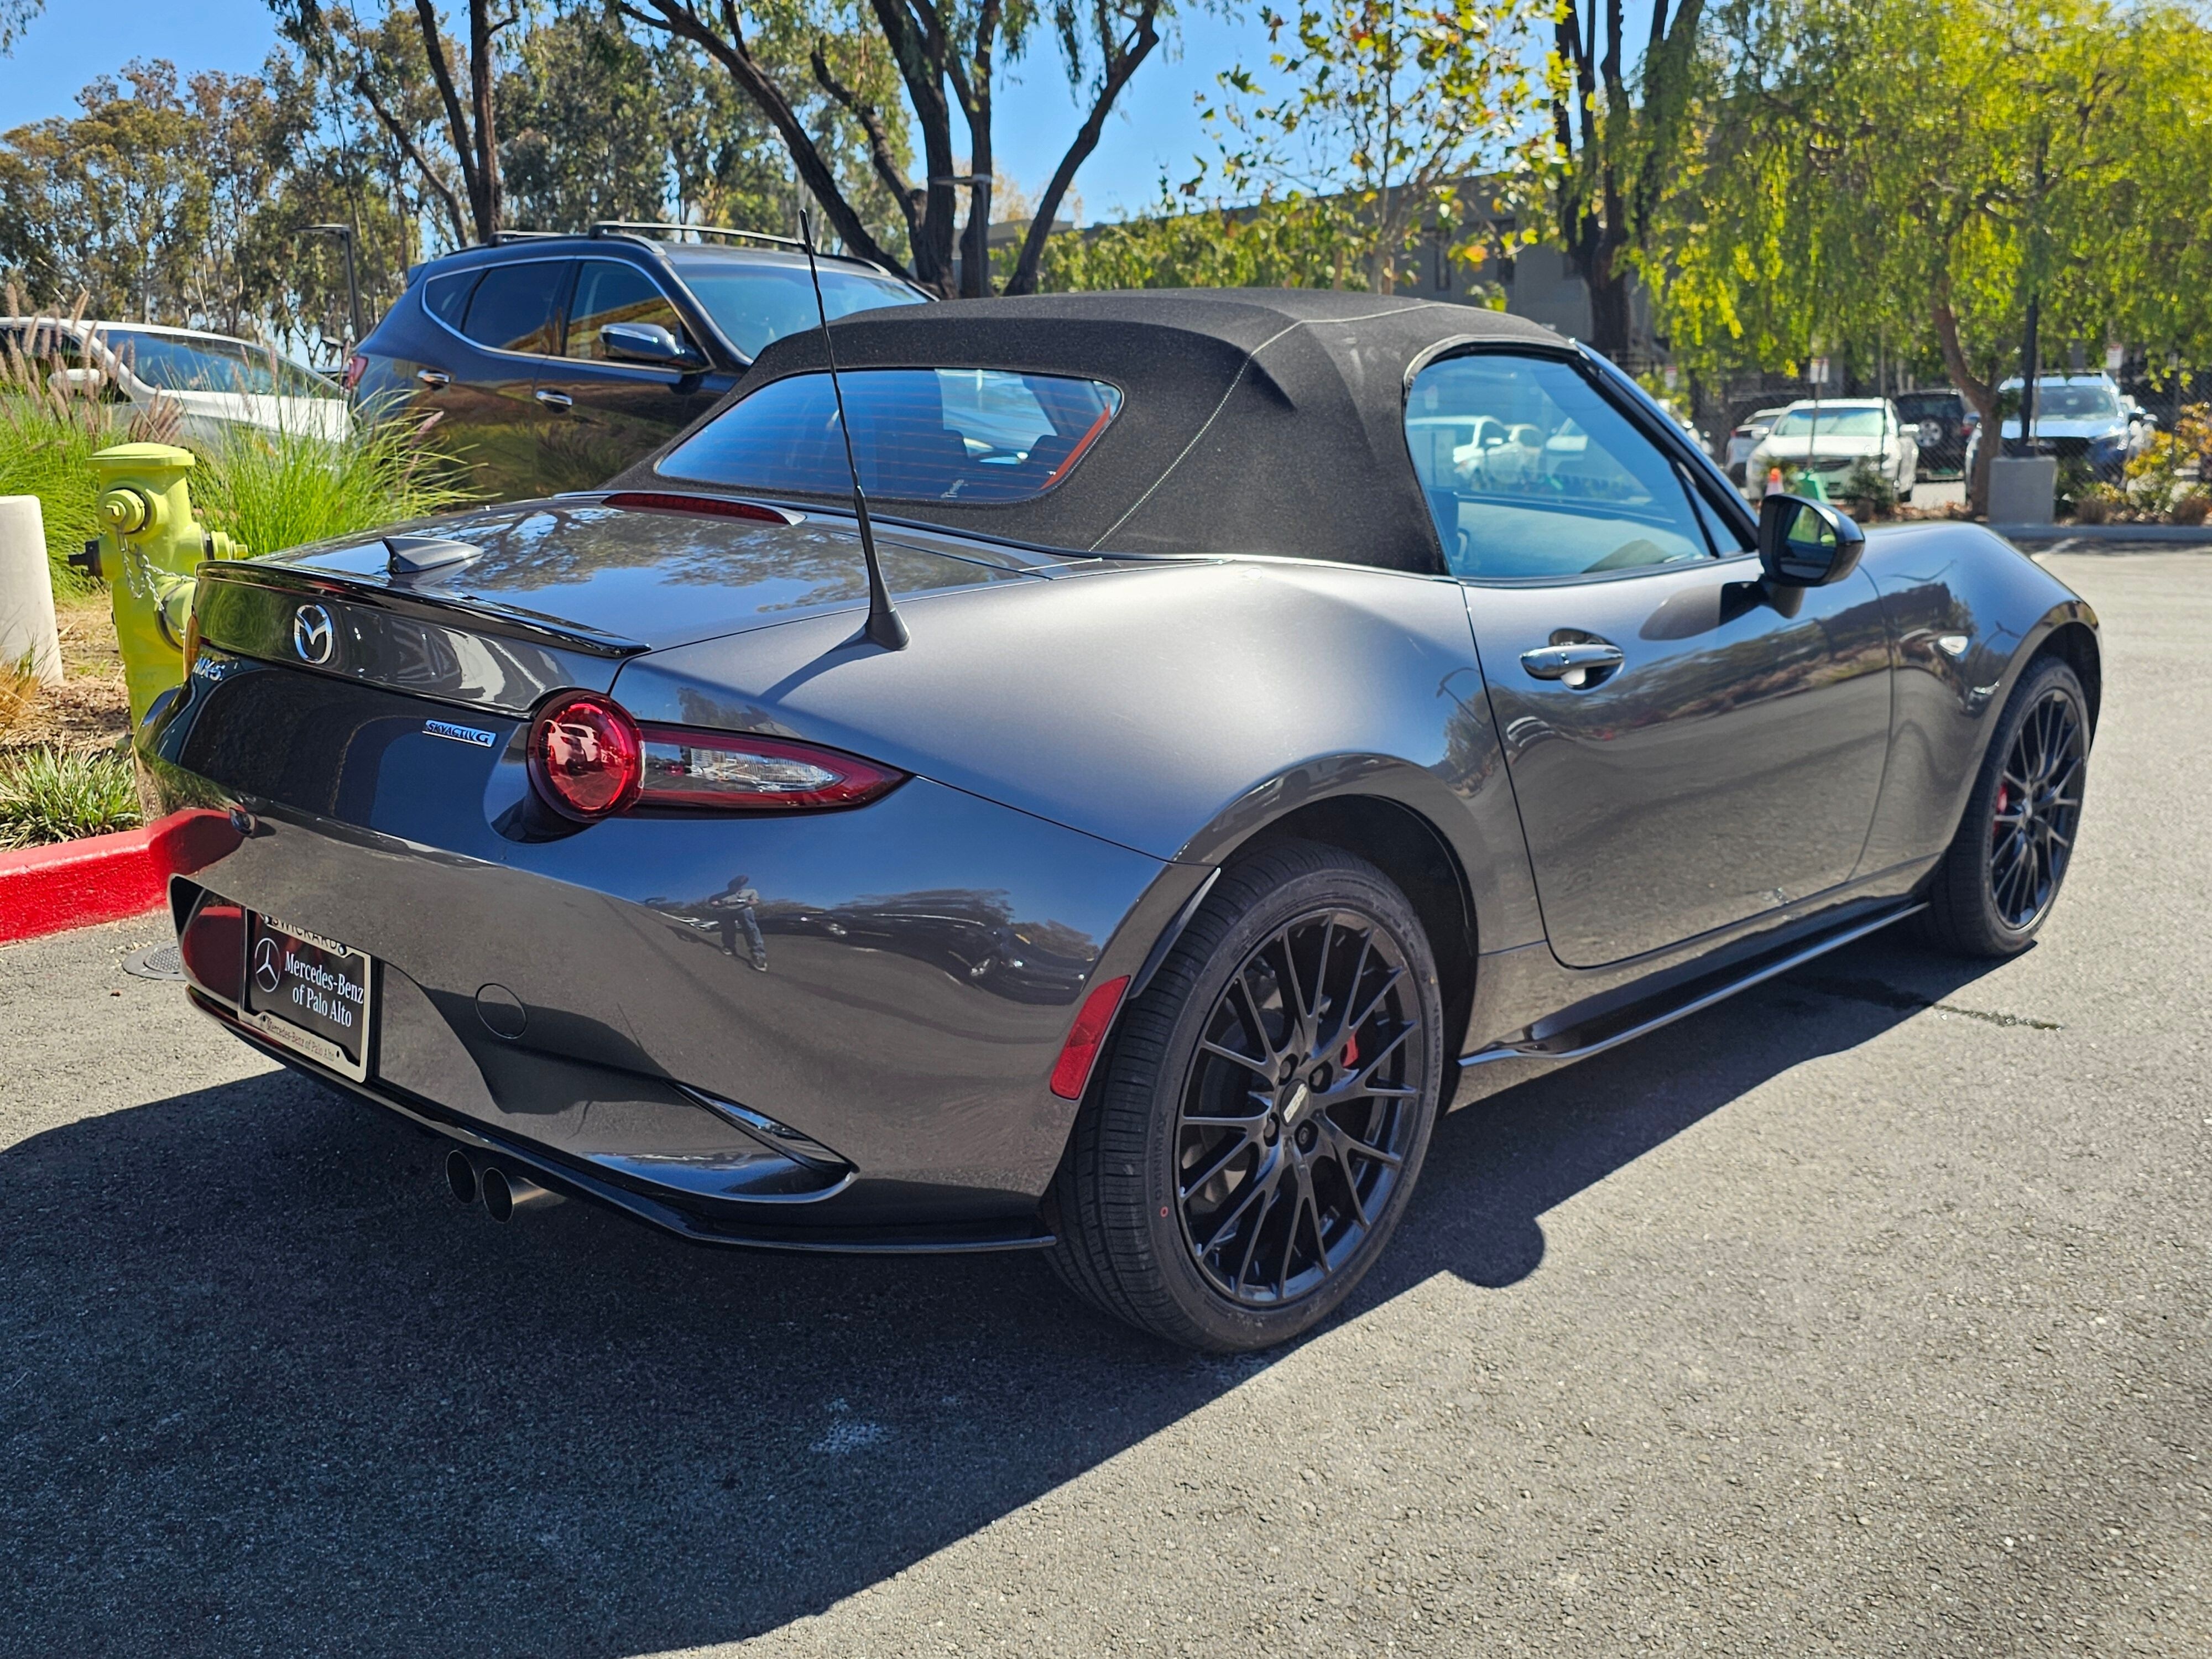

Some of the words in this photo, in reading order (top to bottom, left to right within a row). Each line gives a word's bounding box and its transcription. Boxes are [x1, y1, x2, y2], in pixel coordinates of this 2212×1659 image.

[285, 951, 364, 1004] Mercedes-Benz
[293, 984, 305, 1005] of
[306, 987, 328, 1016] Palo
[329, 1000, 352, 1027] Alto
[1284, 1083, 1307, 1123] BBS
